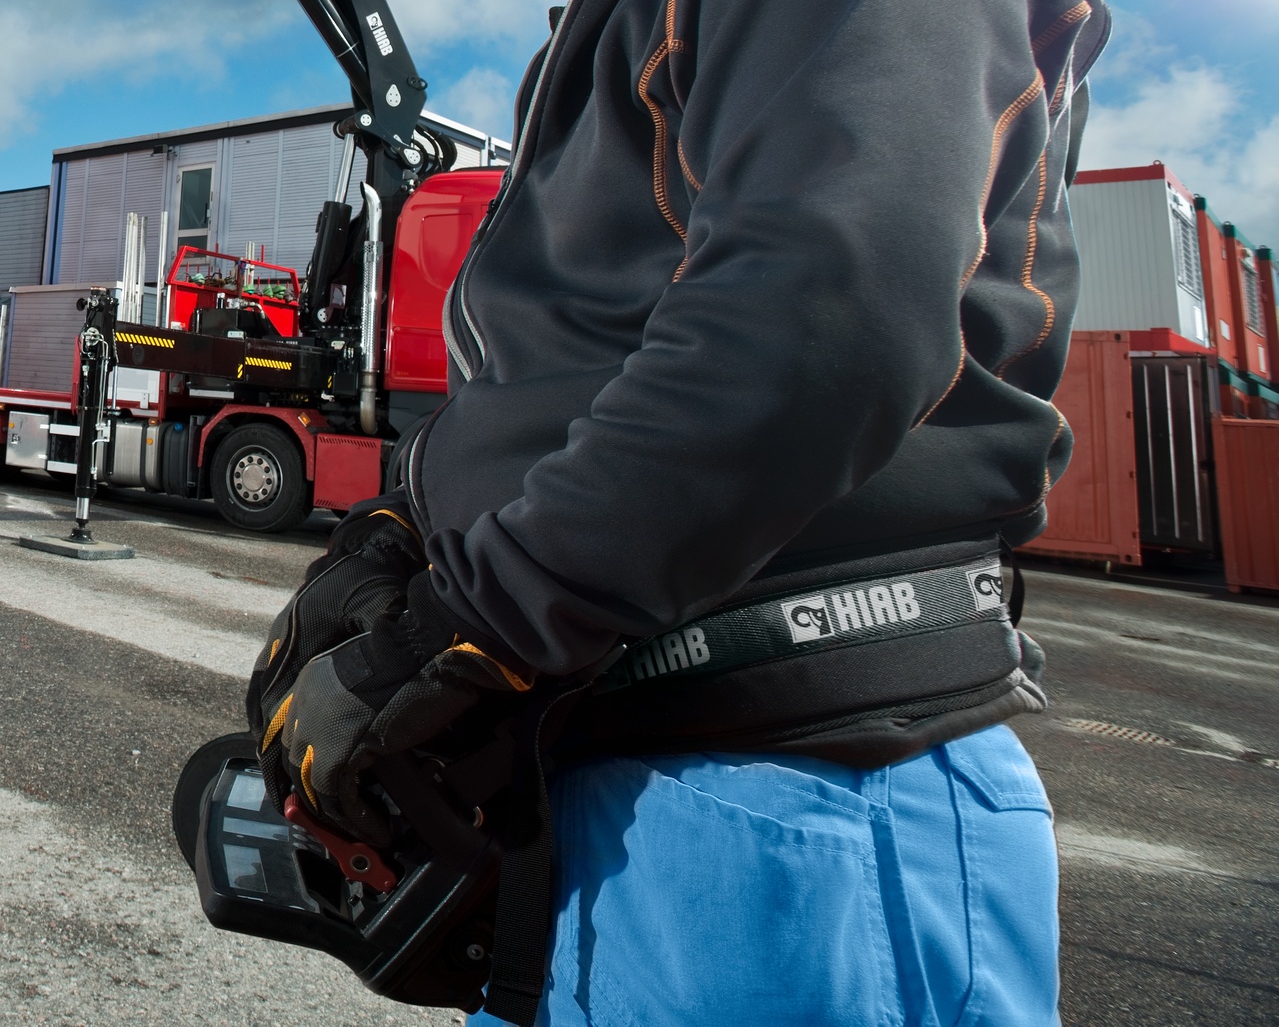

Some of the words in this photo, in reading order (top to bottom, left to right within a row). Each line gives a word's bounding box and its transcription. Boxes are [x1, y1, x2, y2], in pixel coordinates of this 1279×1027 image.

[372, 26, 394, 57] HIAB
[831, 582, 921, 632] HIAB
[629, 627, 711, 681] HIAB
